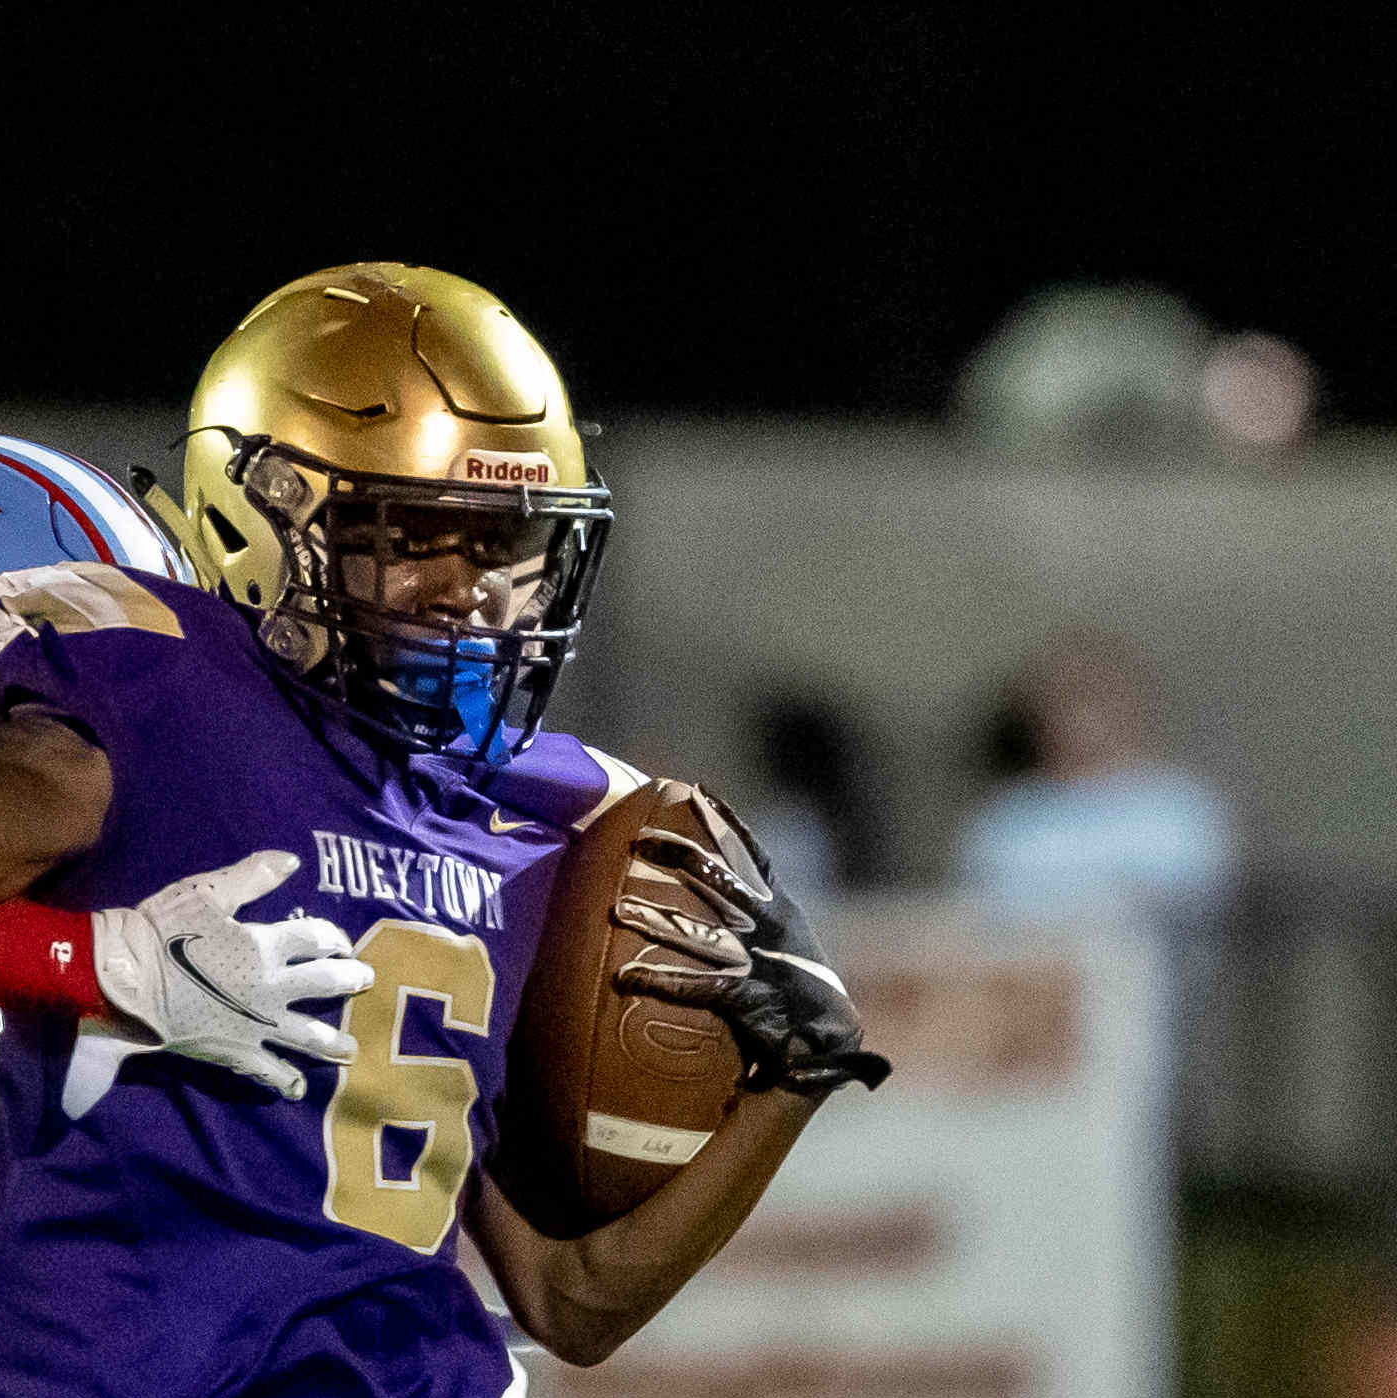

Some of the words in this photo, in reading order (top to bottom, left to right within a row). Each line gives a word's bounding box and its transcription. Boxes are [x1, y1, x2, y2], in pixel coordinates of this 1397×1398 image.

[466, 457, 550, 483] Riddell
[312, 830, 504, 930] HUEYTOWN
[323, 918, 496, 1256] 6
